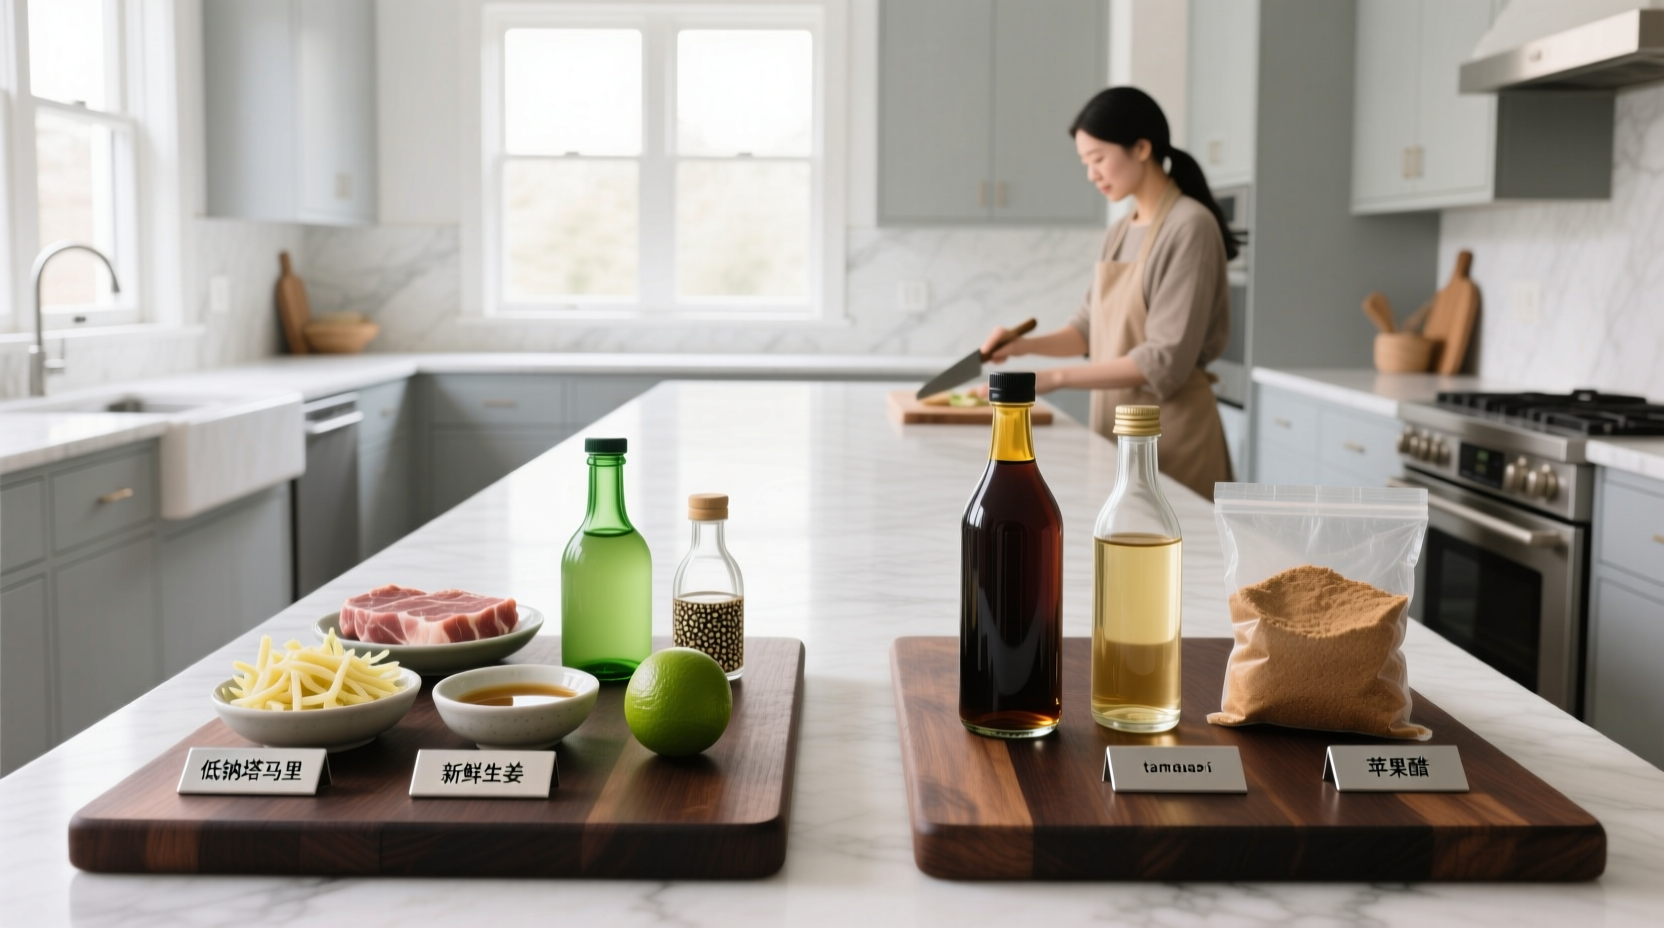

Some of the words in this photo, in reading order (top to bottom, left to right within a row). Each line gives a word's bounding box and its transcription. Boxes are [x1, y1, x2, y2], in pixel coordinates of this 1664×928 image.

[441, 761, 524, 784] 新鲜生姜
[1366, 756, 1430, 778] 苹果醋
